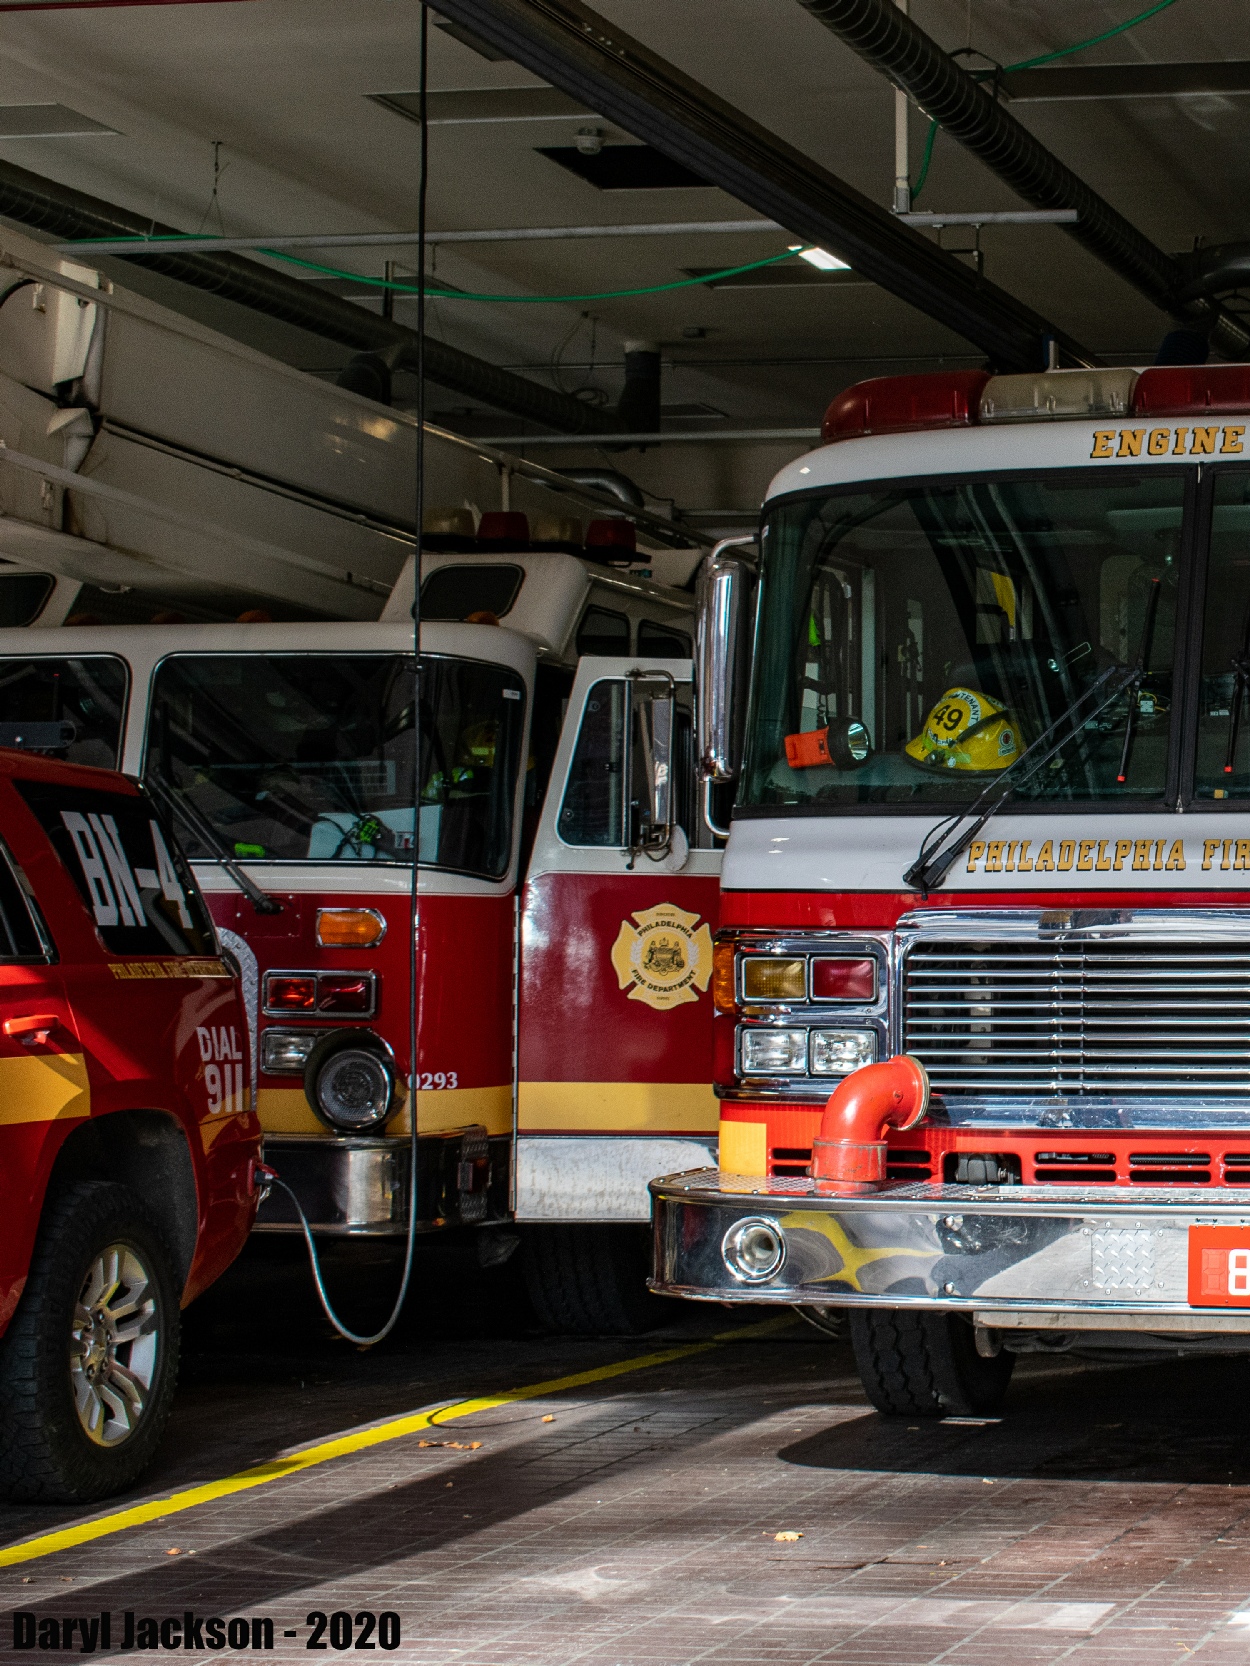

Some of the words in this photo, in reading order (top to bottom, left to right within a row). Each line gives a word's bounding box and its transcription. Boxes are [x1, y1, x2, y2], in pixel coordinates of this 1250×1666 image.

[1090, 426, 1246, 458] ENGINE
[933, 704, 964, 731] 49
[60, 811, 194, 929] BN-4
[966, 839, 1187, 872] PHILADELPHIA
[637, 920, 694, 939] PHILADELPHIA
[631, 969, 646, 986] FIRE
[647, 969, 697, 993] DEPARTMENT
[196, 1026, 243, 1062] DIAL
[204, 1063, 243, 1114] 911
[405, 1071, 459, 1090] 0293
